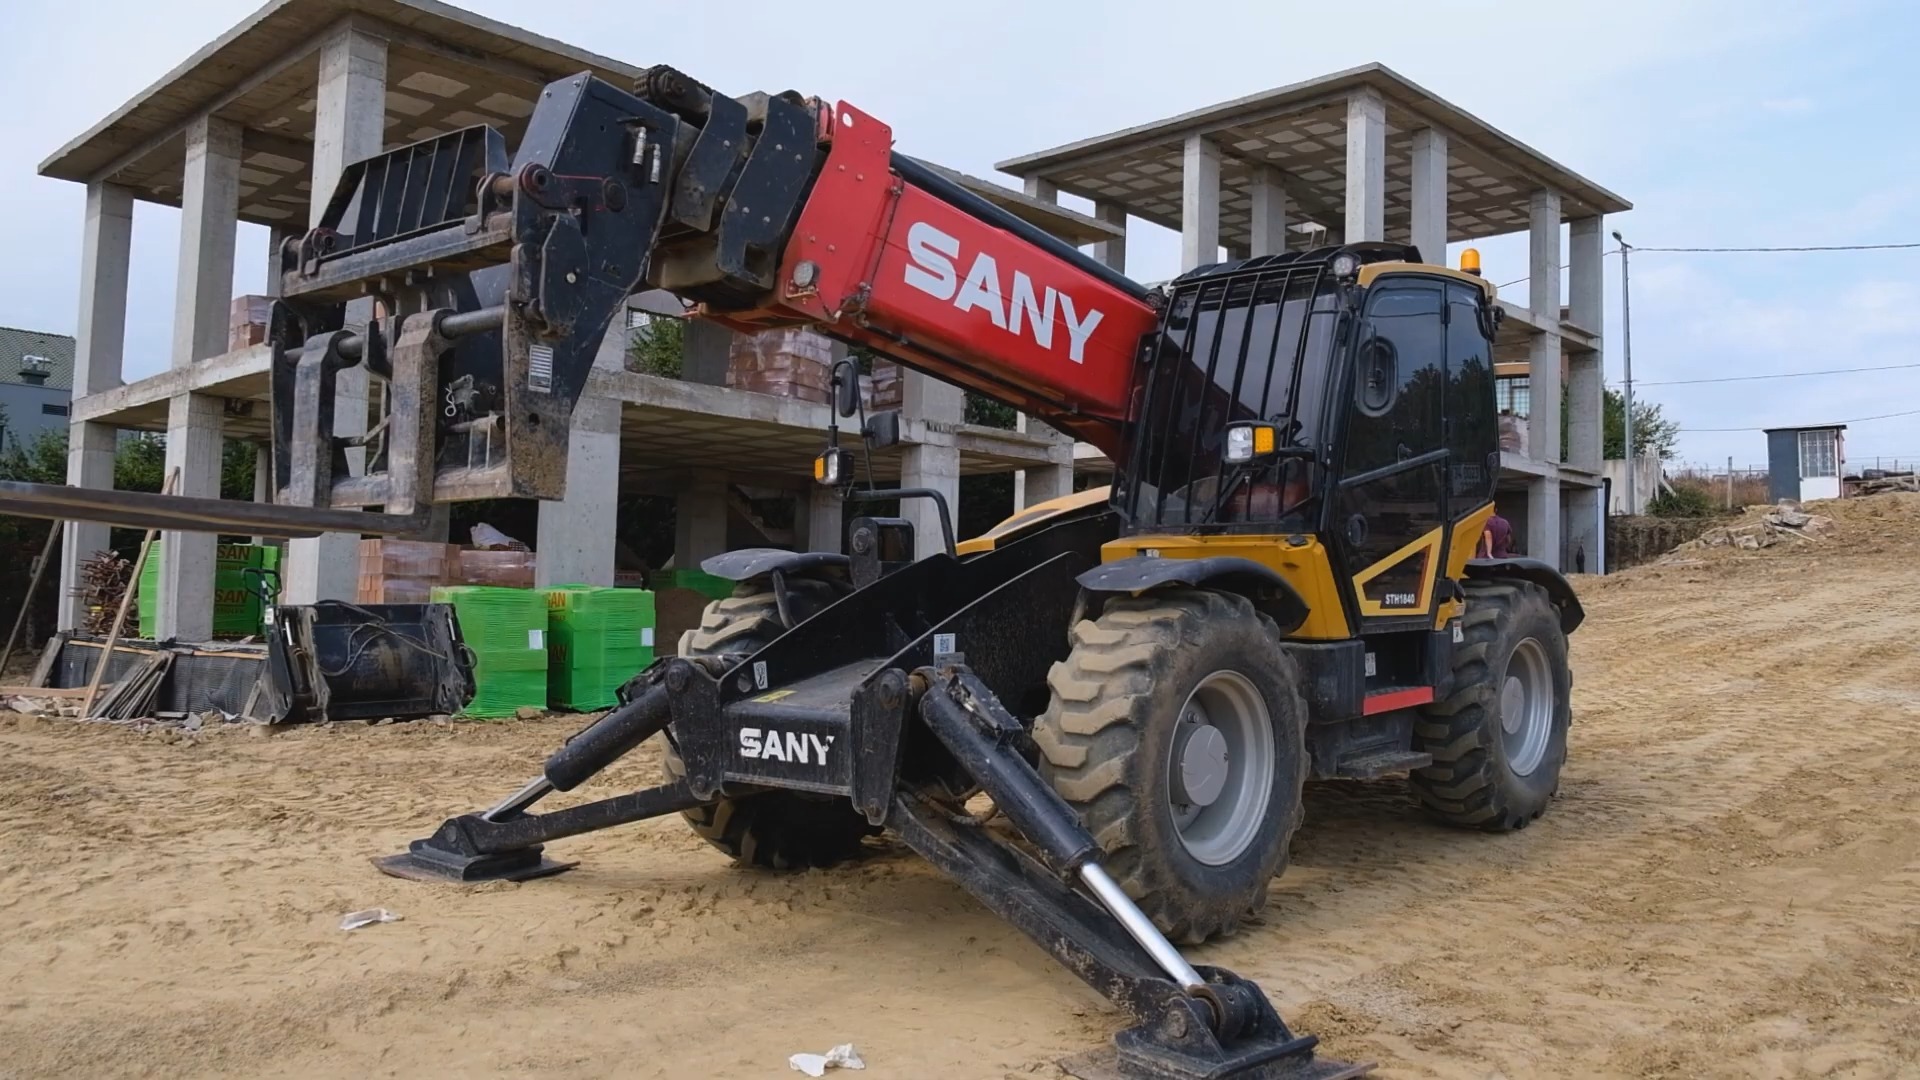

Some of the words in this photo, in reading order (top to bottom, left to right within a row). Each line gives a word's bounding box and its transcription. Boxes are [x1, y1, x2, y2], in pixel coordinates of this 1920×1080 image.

[904, 221, 1104, 365] SANY
[1385, 593, 1416, 605] STH1840
[740, 727, 835, 766] SANY
